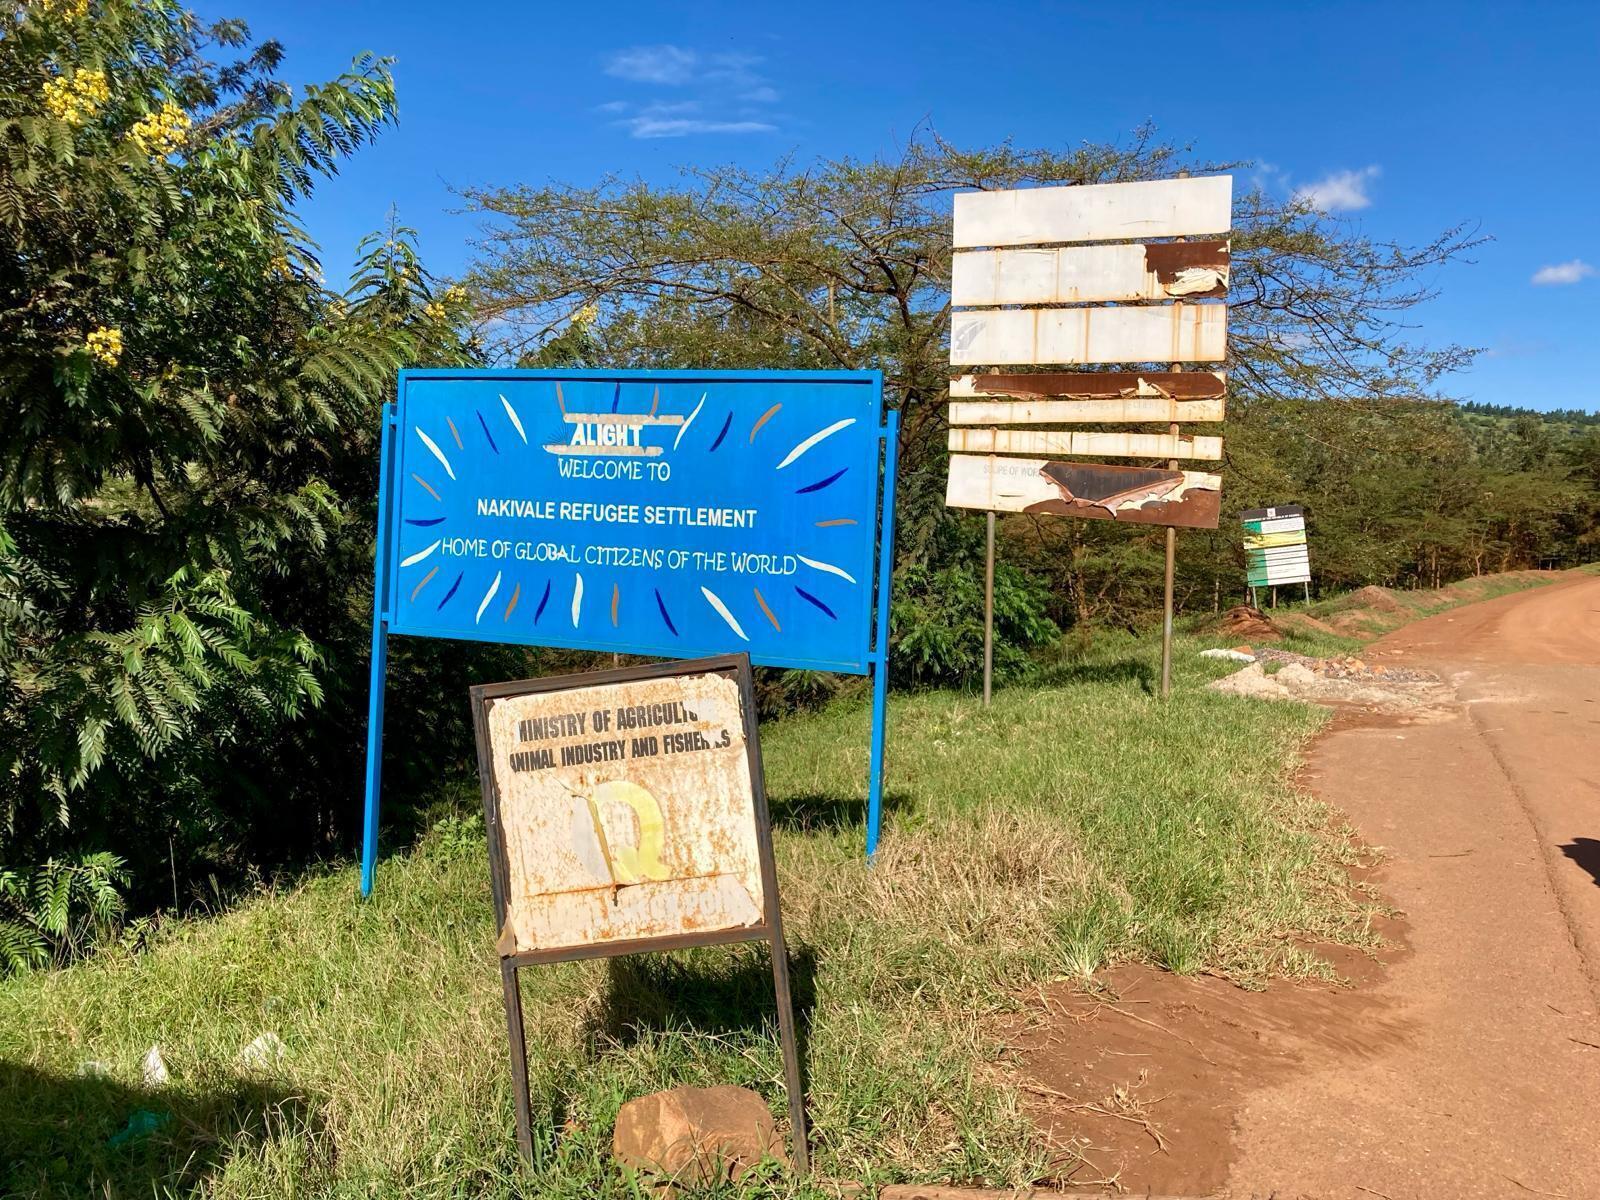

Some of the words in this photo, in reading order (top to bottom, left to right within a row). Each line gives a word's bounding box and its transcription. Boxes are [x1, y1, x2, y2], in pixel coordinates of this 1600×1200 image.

[570, 423, 643, 447] ALIGHT
[558, 458, 643, 480] WELCOME
[646, 461, 671, 482] TO
[477, 498, 555, 520] NAKIVALE
[559, 502, 639, 524] REFUGEE
[644, 505, 758, 529] SETTLEMENT
[441, 537, 488, 558] HOME
[491, 539, 512, 559] OF
[515, 541, 581, 563] GLOBAL
[584, 545, 664, 570] CITIZENS
[667, 549, 690, 570] OF
[692, 551, 727, 572] THE
[731, 552, 797, 575] WORLD
[592, 709, 611, 733] OF
[561, 740, 626, 767] INDUSTRY
[632, 736, 658, 759] AND
